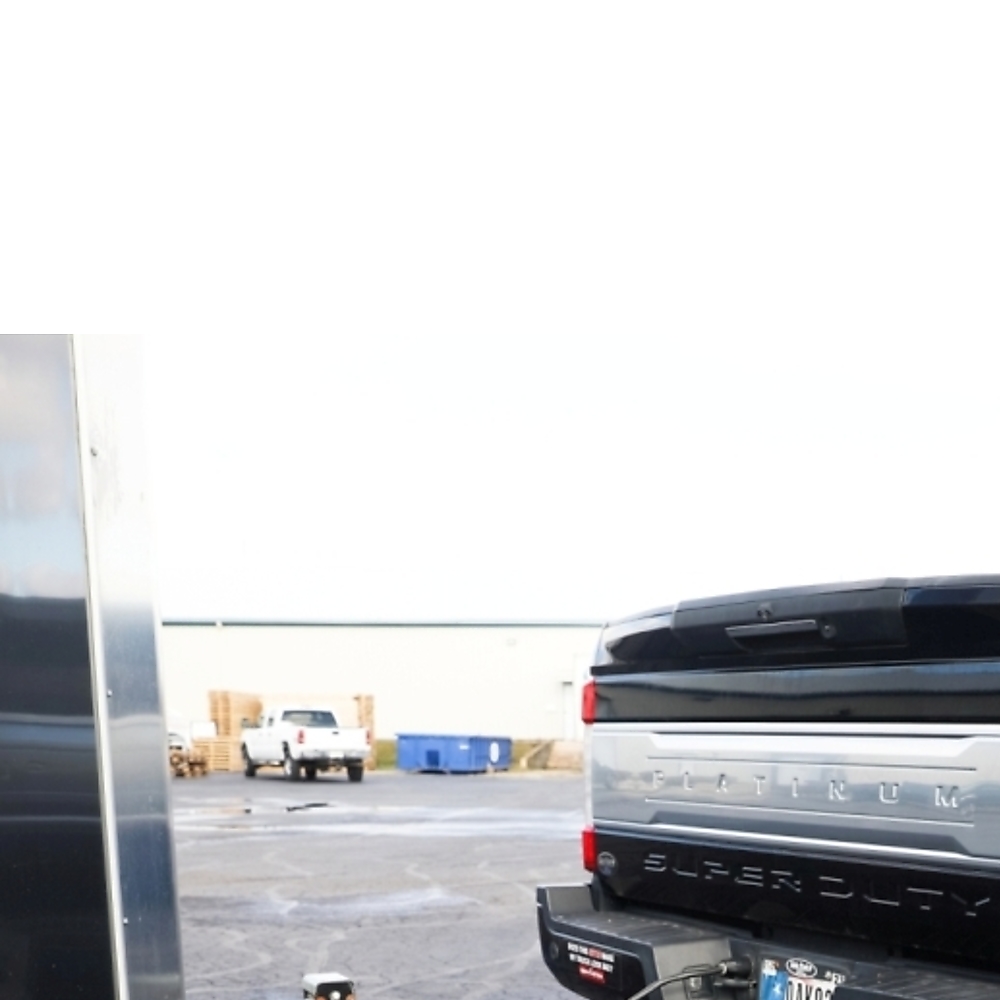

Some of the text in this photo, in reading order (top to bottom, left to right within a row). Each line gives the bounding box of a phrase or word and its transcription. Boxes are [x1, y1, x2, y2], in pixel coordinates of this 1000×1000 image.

[652, 769, 959, 808] PLATINUM
[644, 853, 990, 917] SUPER DUTY
